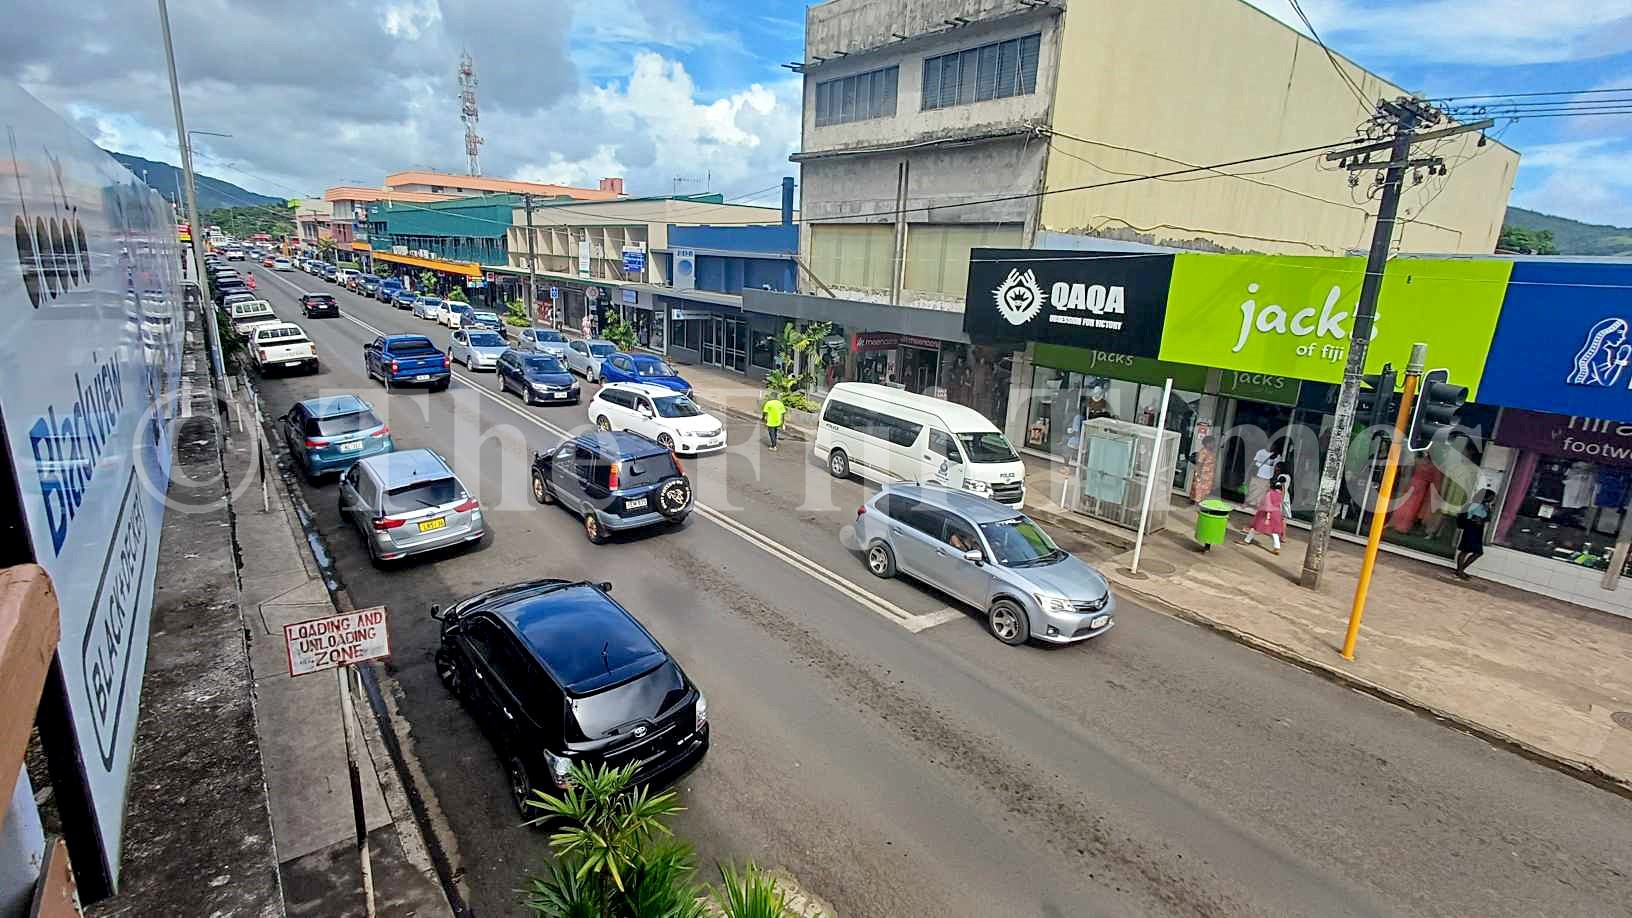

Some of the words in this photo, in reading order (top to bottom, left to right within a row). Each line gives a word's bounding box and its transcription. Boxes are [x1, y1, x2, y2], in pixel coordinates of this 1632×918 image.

[1051, 282, 1126, 315] QAQA
[1296, 343, 1317, 357] of
[1321, 344, 1345, 363] fiji
[29, 352, 124, 559] Blackview
[1563, 437, 1632, 460] footw
[289, 618, 350, 641] LOADING
[357, 612, 382, 628] AND
[300, 627, 376, 653] UNLOADING
[314, 644, 363, 667] ZONE
